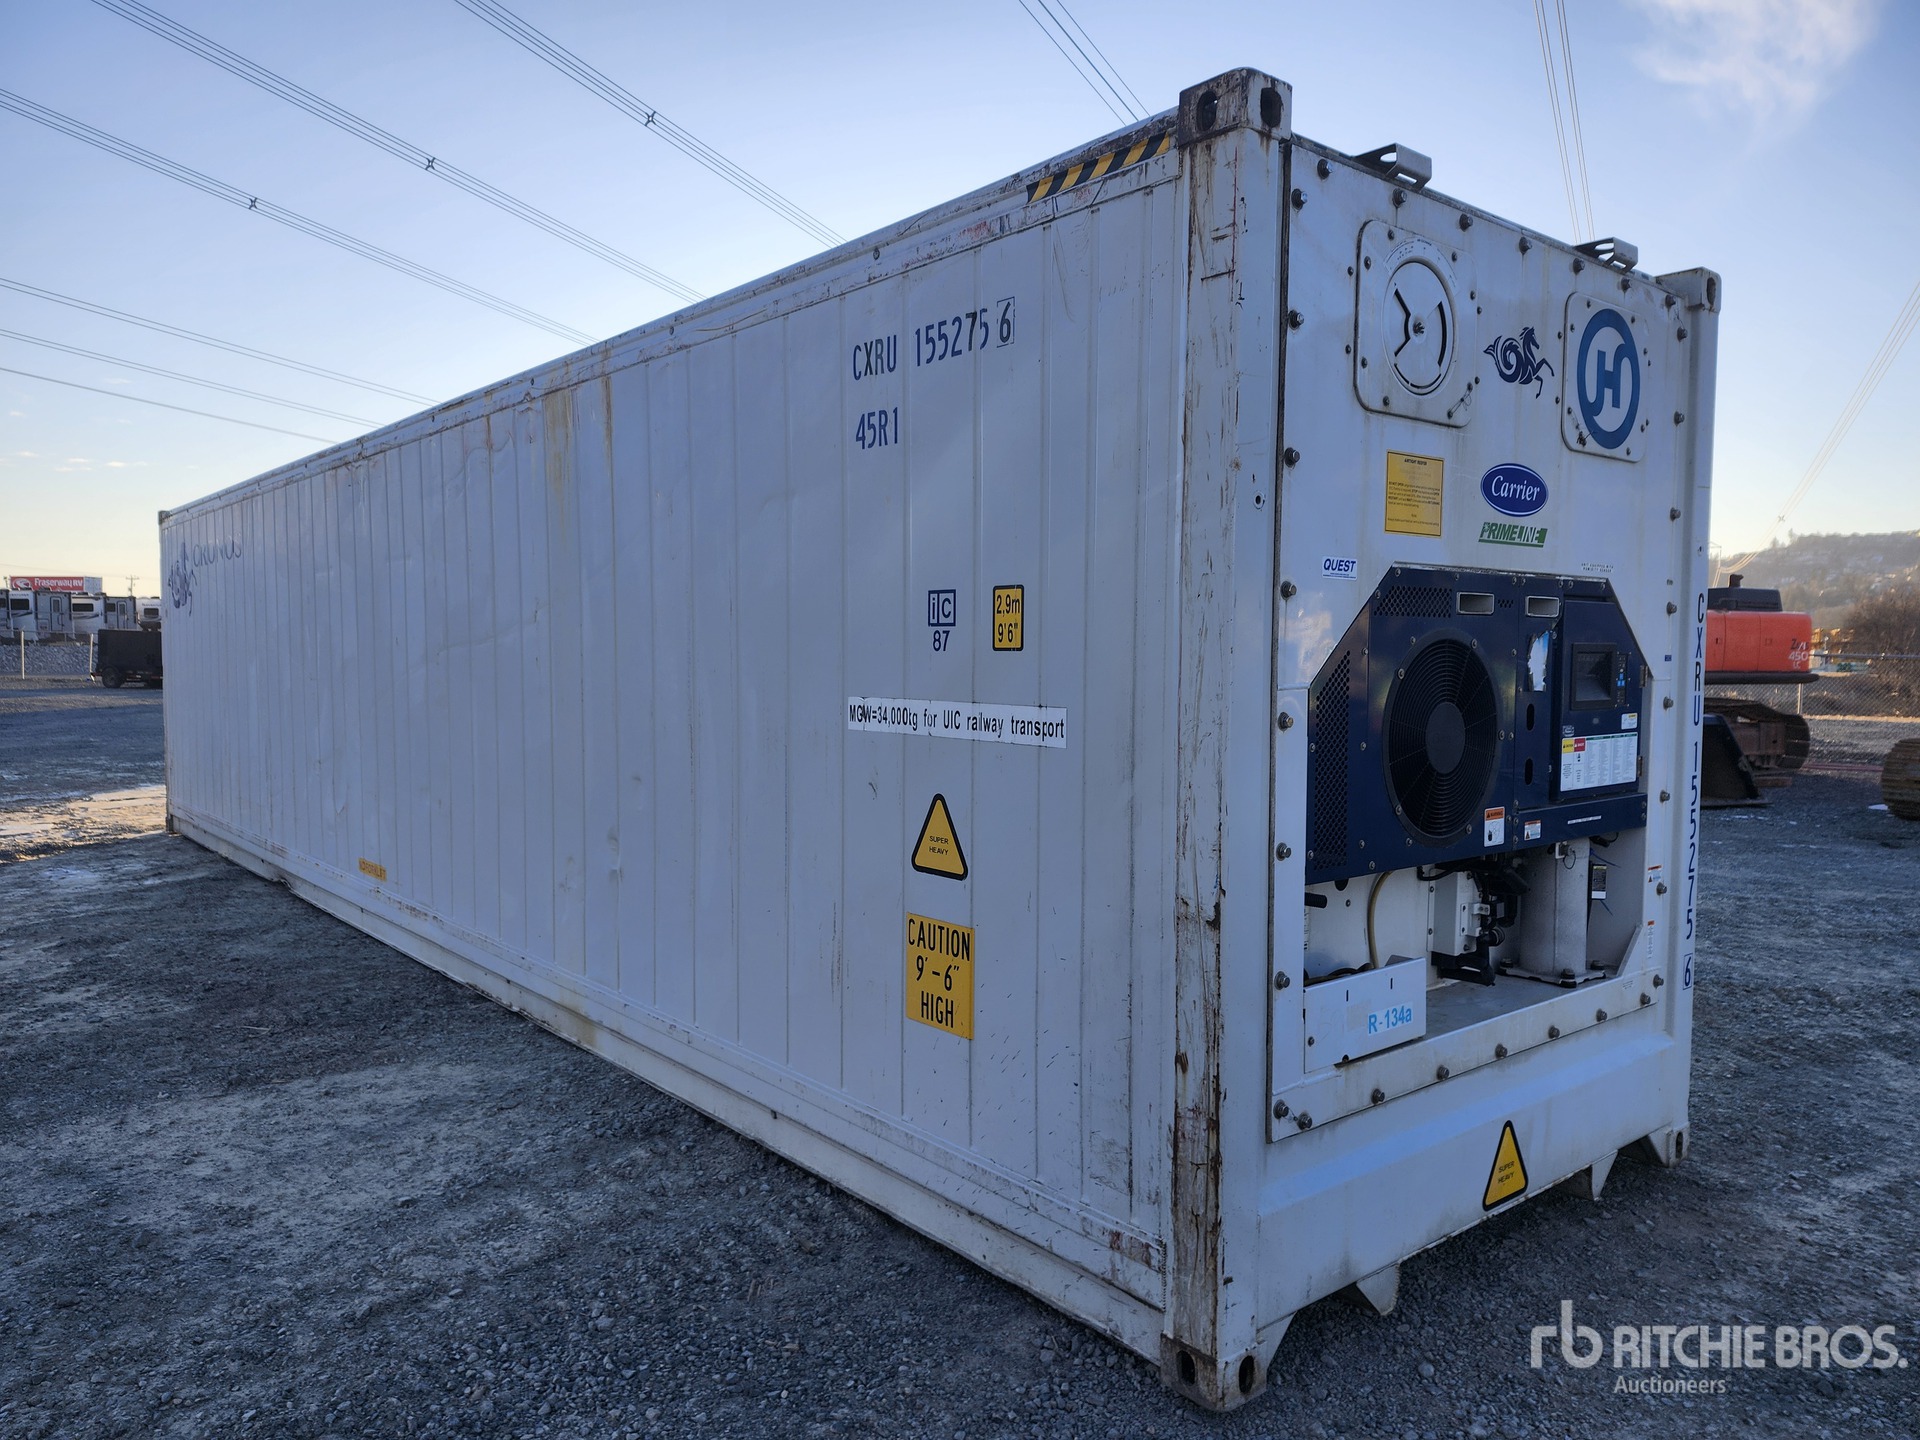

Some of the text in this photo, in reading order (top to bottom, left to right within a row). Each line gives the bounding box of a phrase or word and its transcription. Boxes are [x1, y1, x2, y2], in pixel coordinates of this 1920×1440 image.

[853, 301, 1012, 381] CXRU 155275 6
[856, 406, 898, 450] 45R1
[1491, 475, 1540, 501] Carrier
[1323, 558, 1357, 572] QUEST
[34, 578, 83, 588] Fraserway RV
[933, 630, 950, 651] 87
[1693, 592, 1705, 727] CXRU
[923, 708, 938, 728] for
[943, 710, 961, 730] UIC
[966, 711, 1004, 738] railway
[1010, 715, 1065, 742] transport
[928, 846, 949, 856] HEAVY
[929, 835, 949, 845] SUPER
[1686, 741, 1699, 940] 155275
[908, 918, 970, 961] CAUTION
[921, 990, 954, 1028] HIGH
[1368, 1005, 1412, 1034] R-134a
[1498, 1160, 1515, 1173] SUPER
[1498, 1172, 1514, 1184] HEAVY
